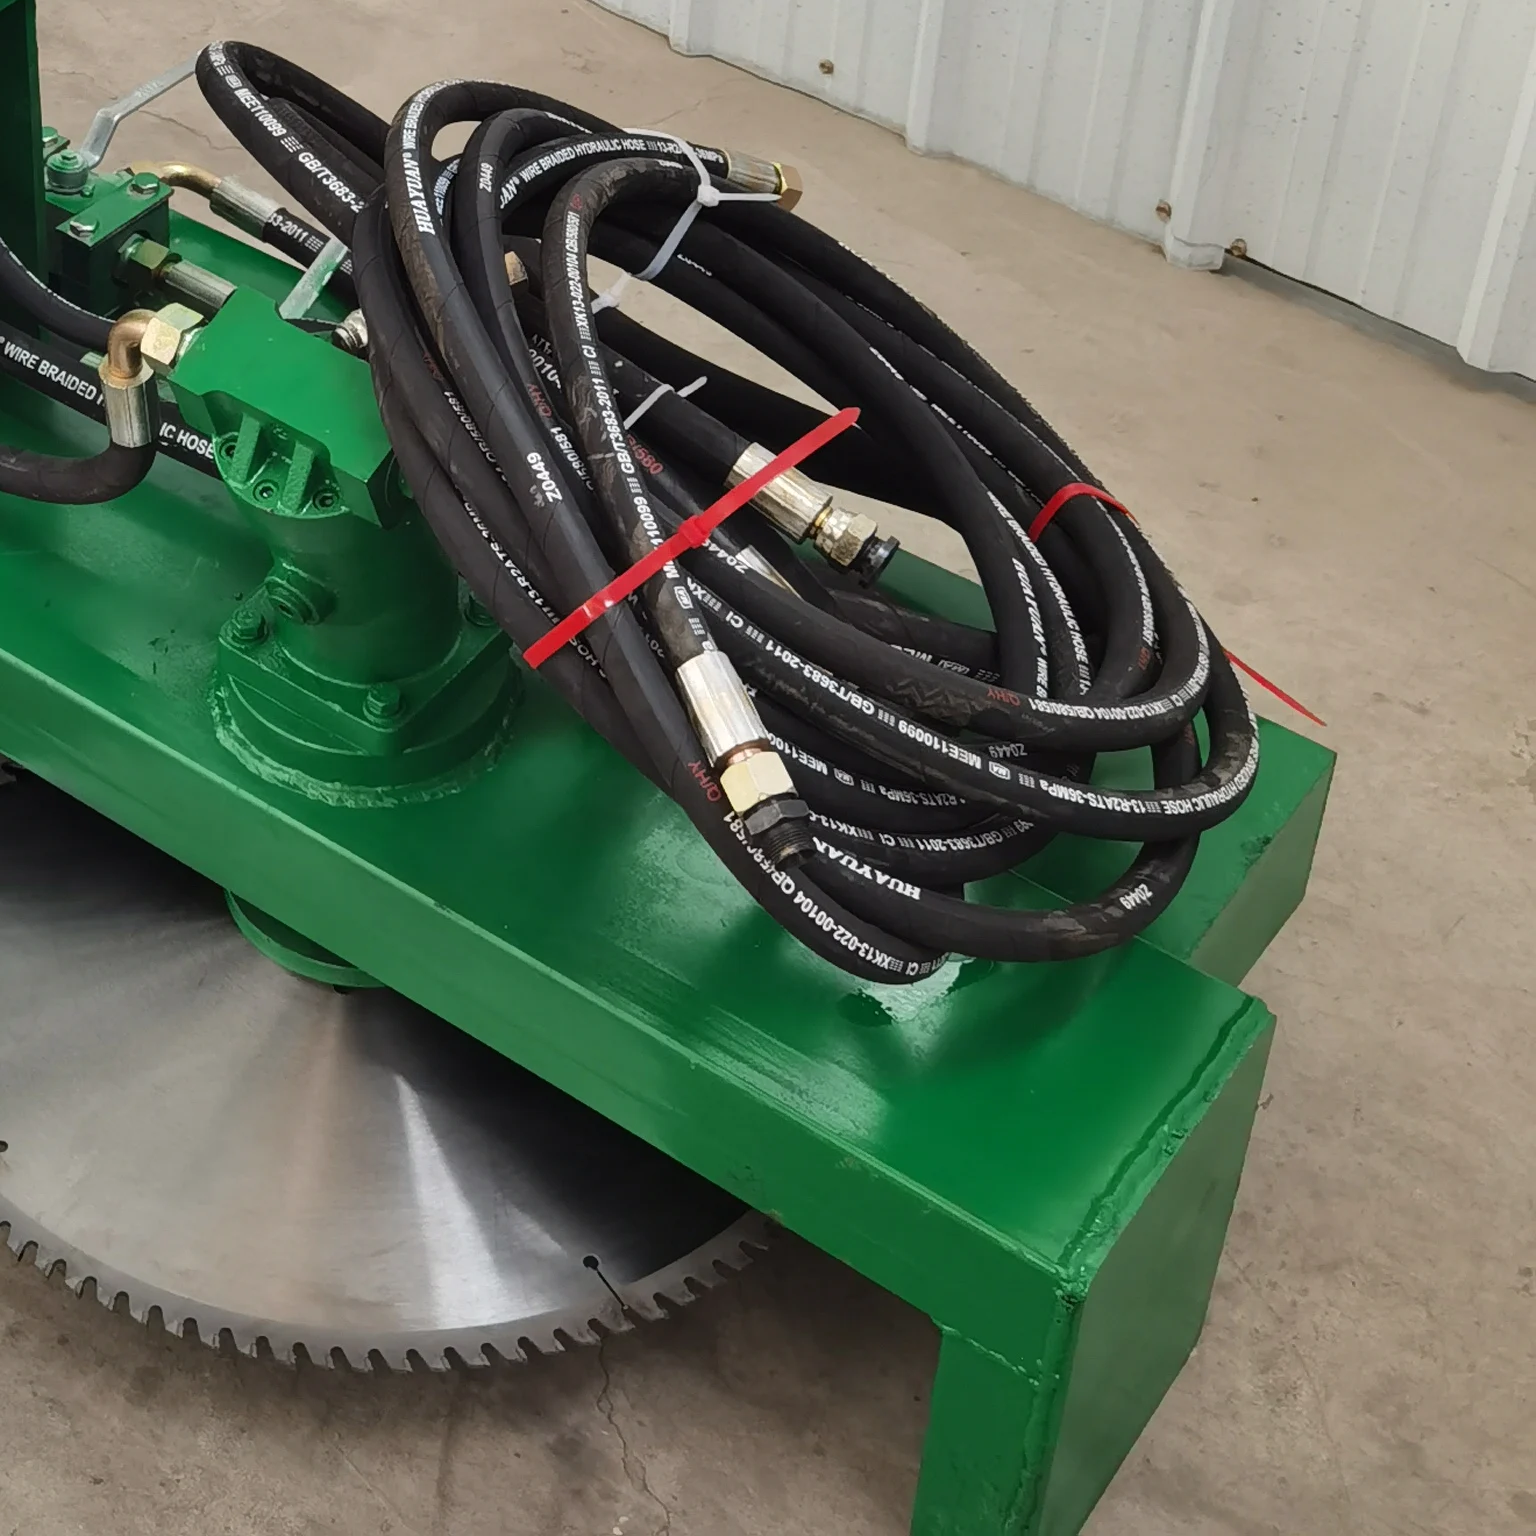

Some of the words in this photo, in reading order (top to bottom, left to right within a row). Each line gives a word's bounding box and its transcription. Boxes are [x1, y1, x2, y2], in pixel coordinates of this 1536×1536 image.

[233, 88, 287, 137] MEE110099
[297, 151, 366, 214] GB/T3683-2
[519, 165, 543, 183] WIRE
[540, 147, 576, 176] BRAIDED
[573, 138, 622, 161] HYDRAULIC
[621, 138, 647, 152] HOSE
[3, 340, 38, 371] WIRE
[37, 359, 98, 401] BRAIDED
[591, 377, 635, 475] GB/T3683-2011
[526, 451, 563, 504] Z0449
[568, 636, 599, 667] HOS
[1069, 628, 1089, 666] HOSE
[765, 639, 876, 716] GB/T3683-2011
[897, 719, 983, 770] MEE110099
[689, 761, 723, 803] Q/HY
[1163, 797, 1193, 815] HOSE
[812, 836, 923, 901] HUAYUAN
[1118, 883, 1154, 910] Z0449
[792, 890, 894, 971] XK13-022-00104
